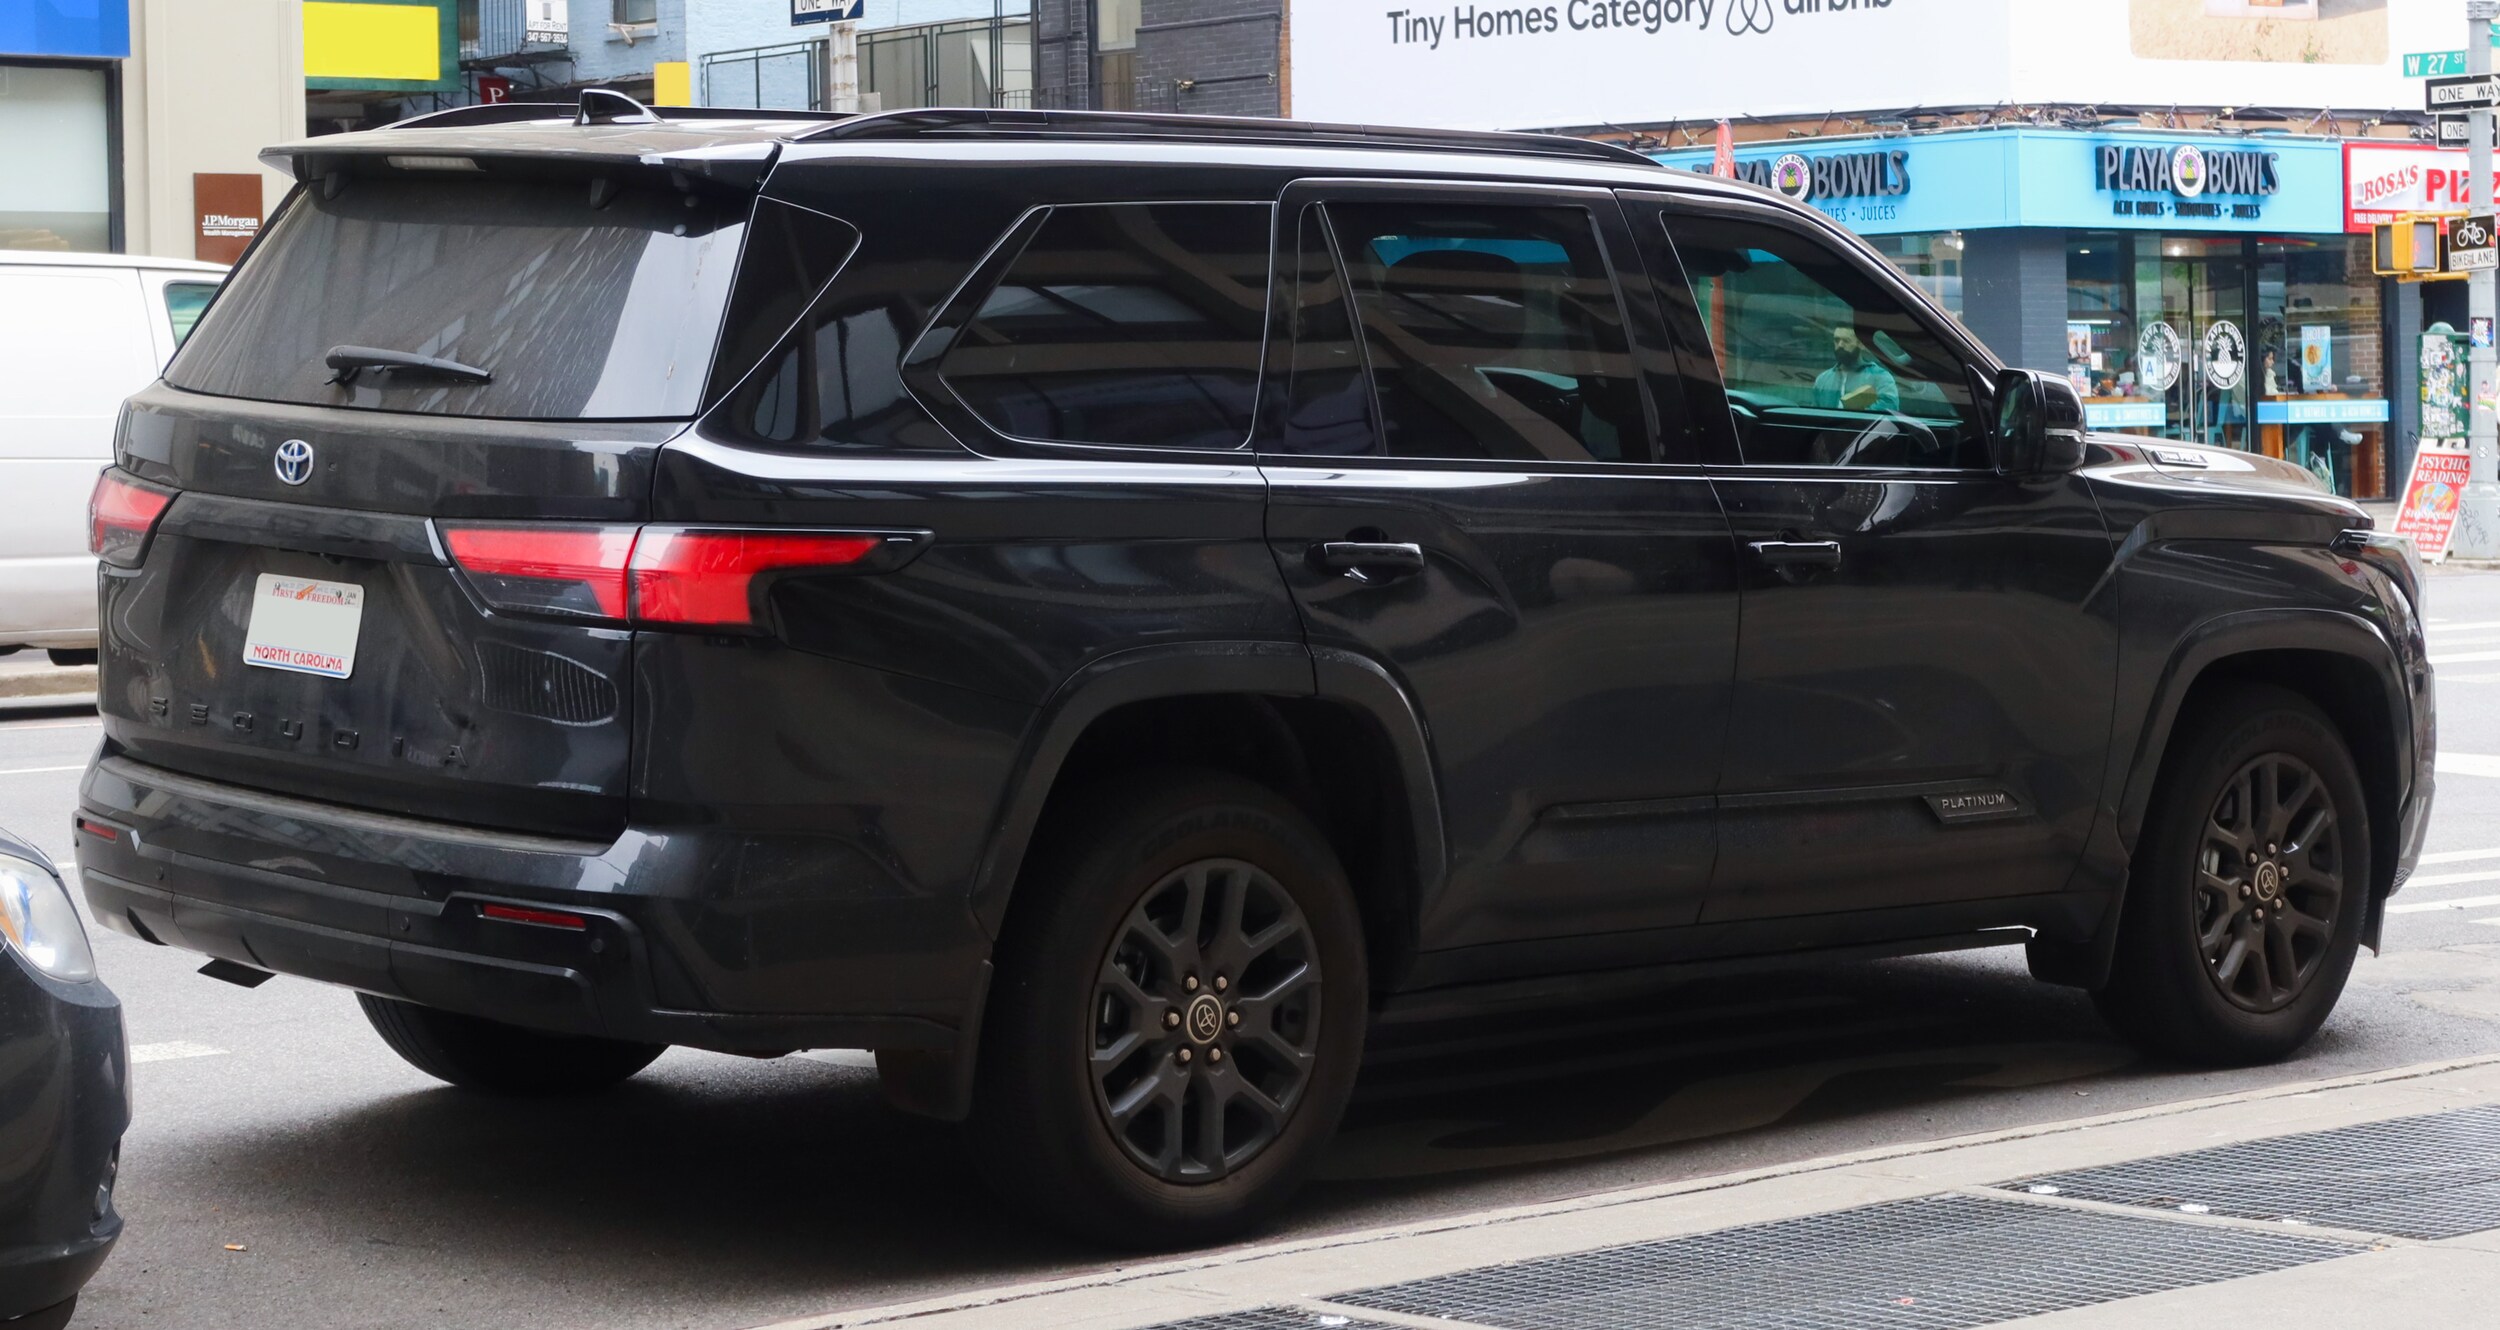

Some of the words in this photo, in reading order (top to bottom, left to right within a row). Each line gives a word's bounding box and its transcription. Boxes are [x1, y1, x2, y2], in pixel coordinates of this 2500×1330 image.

[1386, 10, 1445, 50] Tiny
[1454, 4, 1559, 39] Homes
[1567, 0, 1714, 34] Category
[2407, 55, 2420, 75] W
[2427, 54, 2448, 75] 27
[2454, 52, 2464, 64] ST
[2438, 87, 2464, 101] ONE
[2446, 124, 2464, 137] ONE
[1813, 150, 1910, 200] BOWLS
[2097, 144, 2173, 192] PLAYA
[2207, 150, 2280, 196] BOWLS
[2363, 164, 2419, 203] ROSA'S
[1860, 204, 1897, 221] JUICES
[2354, 213, 2367, 224] FREE
[202, 214, 259, 230] J.P.Morgan
[2451, 254, 2469, 267] BIKE
[2471, 250, 2494, 264] LANE
[2420, 455, 2471, 471] PSYCHIC
[2415, 469, 2467, 485] READING
[272, 588, 293, 599] FIRST
[307, 592, 345, 606] FREEDOM
[253, 645, 291, 663] NORTH
[293, 651, 343, 671] CAROLINA
[149, 696, 468, 768] SEQUOIA
[1941, 793, 2006, 809] PLATINUM
